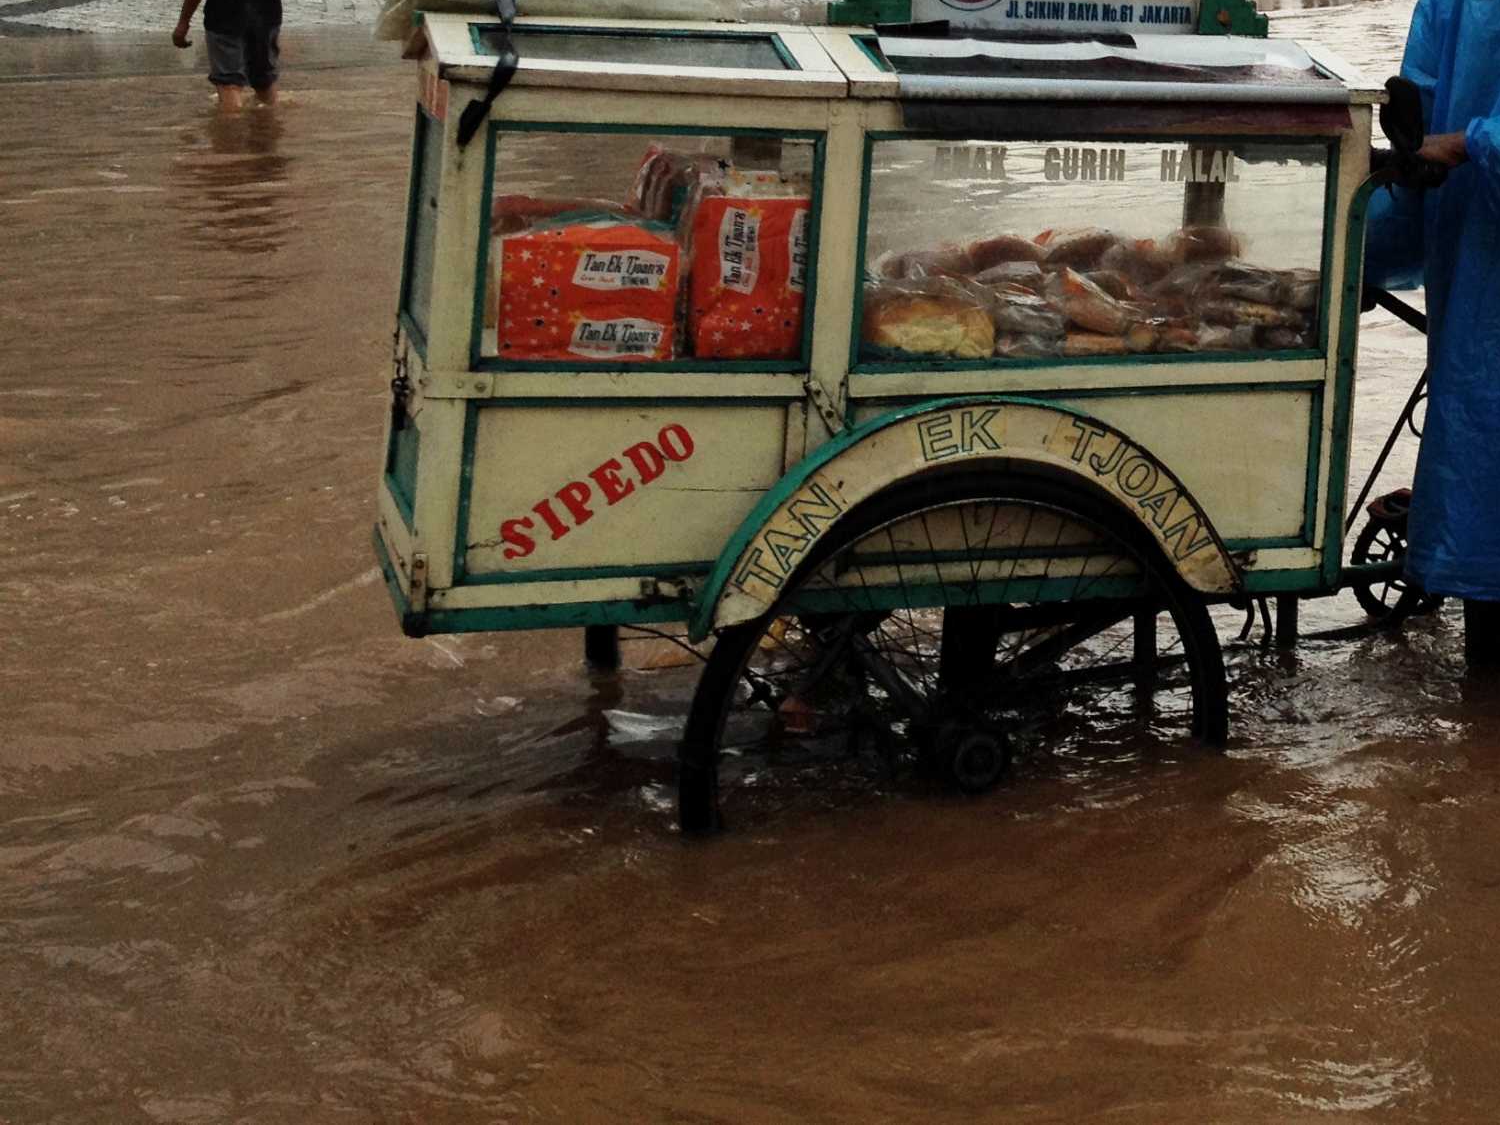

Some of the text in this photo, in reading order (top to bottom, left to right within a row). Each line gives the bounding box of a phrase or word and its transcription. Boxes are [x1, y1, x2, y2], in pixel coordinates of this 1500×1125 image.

[1005, 0, 1023, 19] JL.
[1025, 1, 1065, 20] CIKINI
[1068, 3, 1099, 22] RAYA
[1139, 5, 1192, 25] JAKARTA
[1044, 146, 1125, 181] GURIH
[1160, 149, 1240, 182] HALAL
[583, 254, 606, 272] Tan
[607, 255, 623, 273] Ek
[579, 323, 602, 341] Tan
[500, 421, 696, 559] SIPEDO
[735, 408, 1210, 596] TAN EK TJOAN
